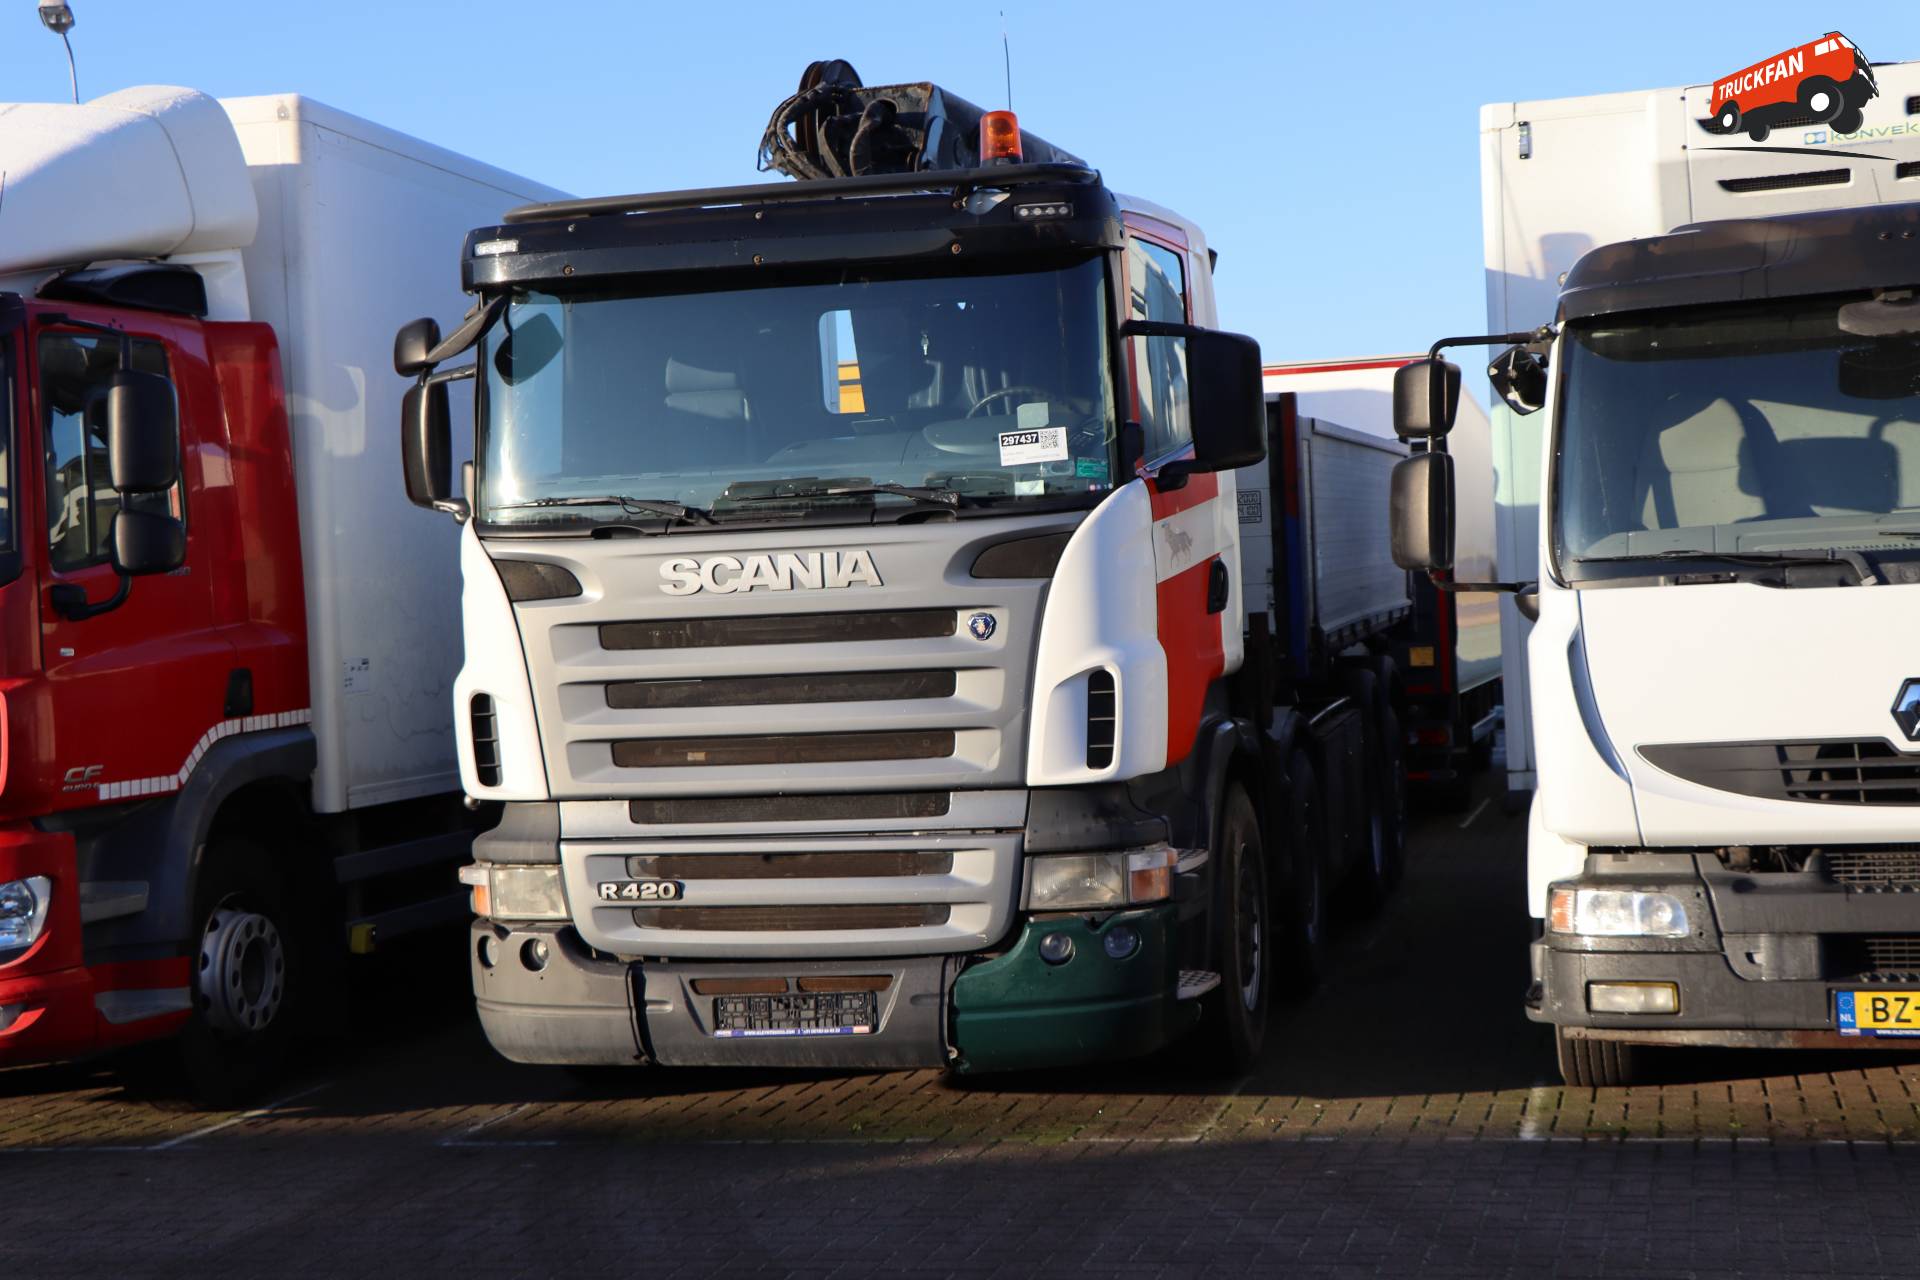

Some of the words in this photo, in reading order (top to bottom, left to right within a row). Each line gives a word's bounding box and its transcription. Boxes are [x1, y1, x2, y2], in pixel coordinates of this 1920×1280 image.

[1002, 433, 1038, 446] 297437
[658, 549, 884, 596] SCANIA
[64, 764, 104, 782] CF
[600, 882, 619, 900] R
[622, 881, 676, 900] 420
[1839, 1013, 1855, 1023] NL
